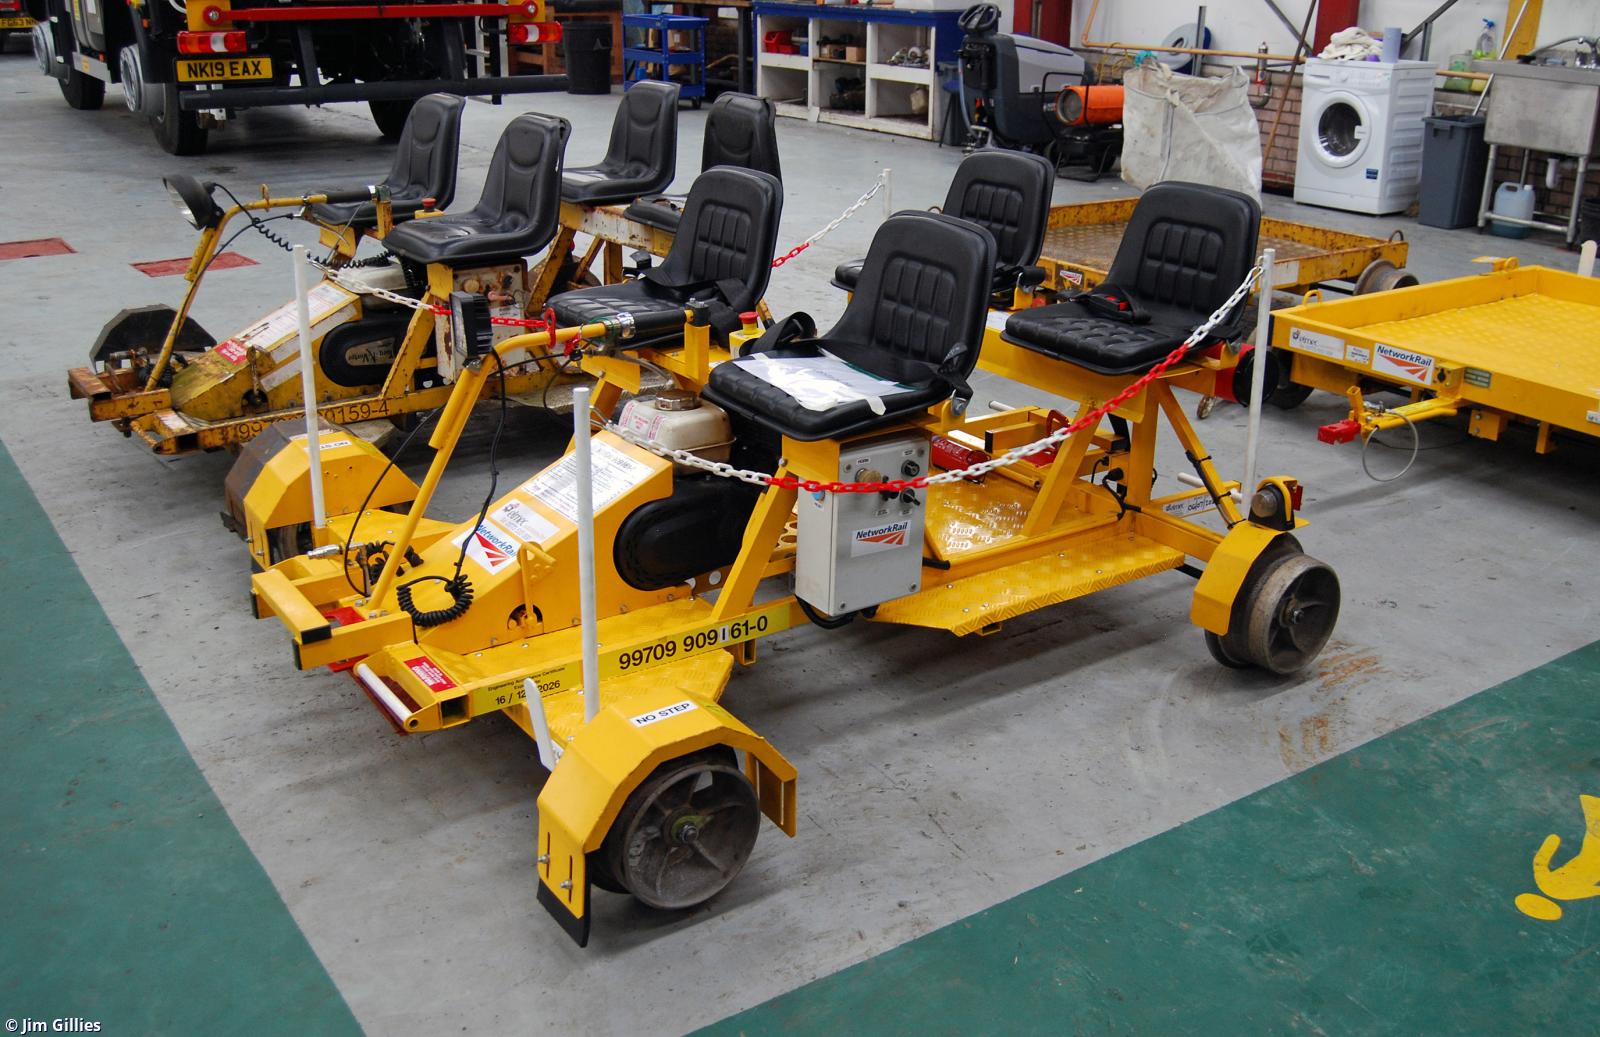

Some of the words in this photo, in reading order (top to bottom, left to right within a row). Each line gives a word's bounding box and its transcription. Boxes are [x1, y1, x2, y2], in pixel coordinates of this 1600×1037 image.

[187, 61, 225, 78] NK19
[229, 60, 262, 76] EAX
[1377, 345, 1432, 367] NetworkRail
[855, 522, 908, 540] NetworkRail
[618, 640, 677, 670] 99709
[495, 695, 506, 705] 16
[508, 692, 513, 704] /
[517, 689, 527, 700] 12
[537, 680, 561, 693] 2026
[635, 714, 657, 725] NO
[658, 702, 692, 718] STEP
